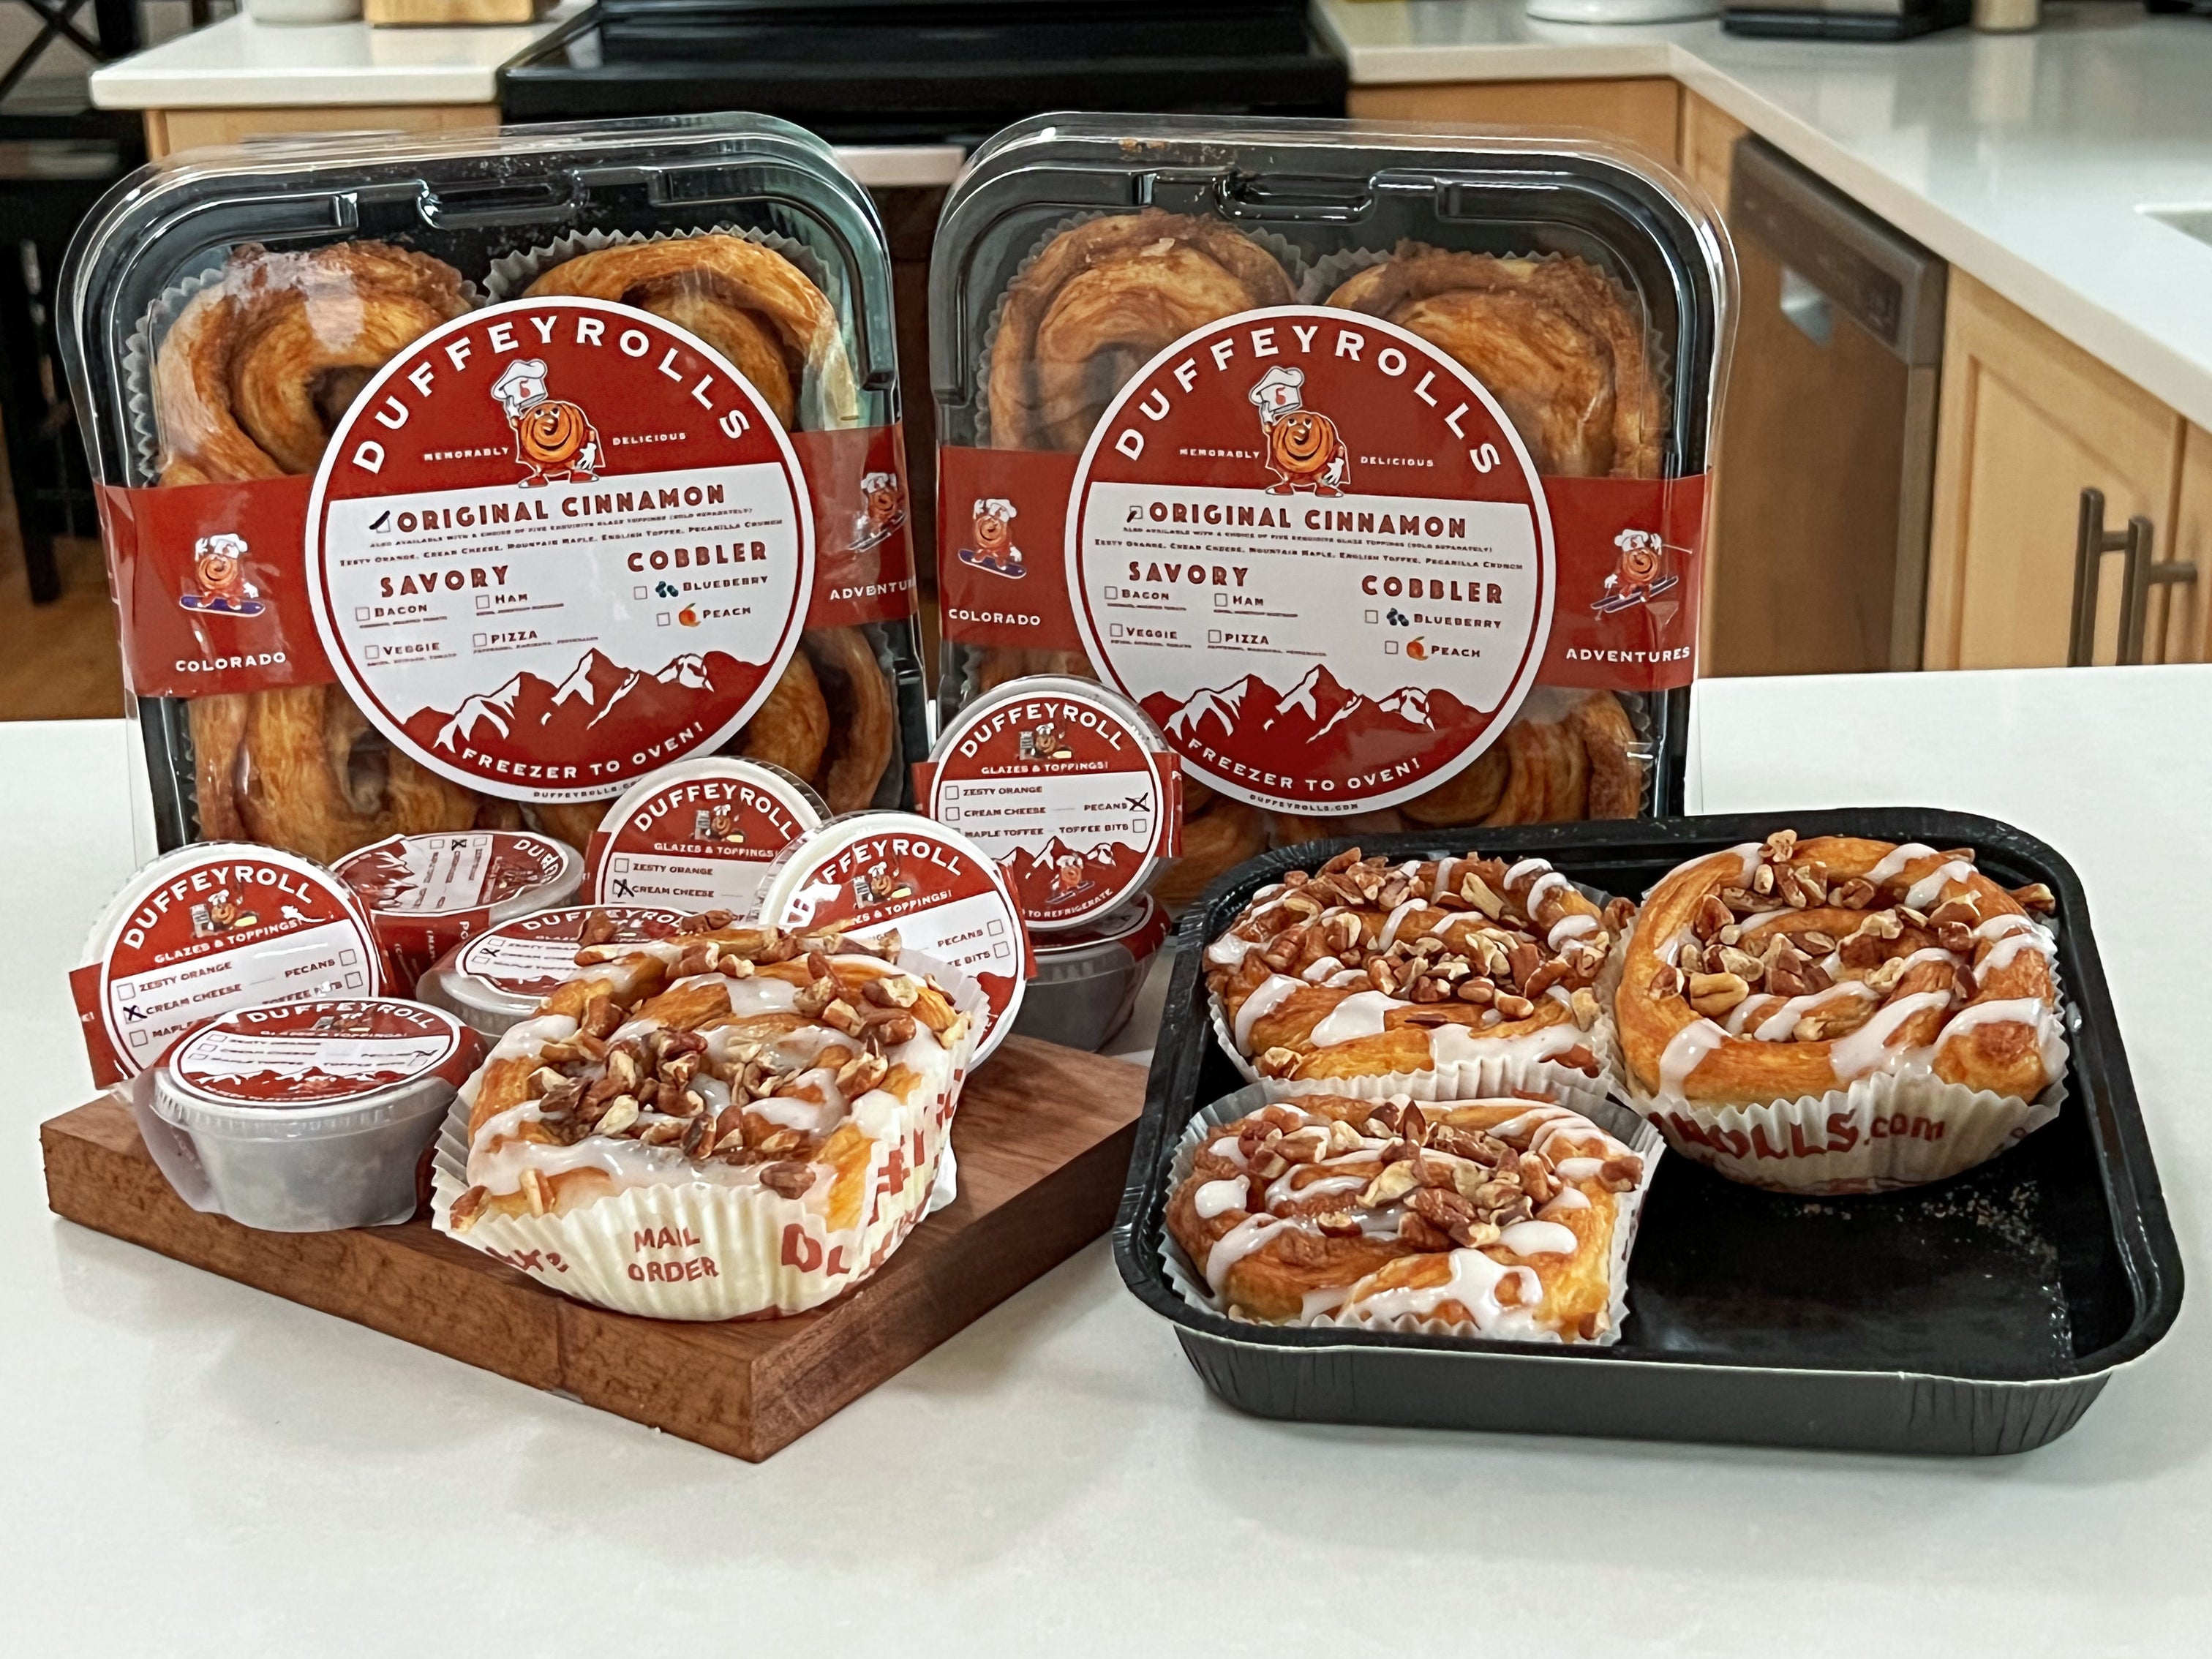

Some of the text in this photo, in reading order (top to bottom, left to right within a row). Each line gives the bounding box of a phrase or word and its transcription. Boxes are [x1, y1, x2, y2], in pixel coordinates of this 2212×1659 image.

[353, 316, 750, 473] DUFFEYROLLS
[1114, 326, 1501, 474] DUFFEYROLLS
[424, 432, 686, 461] MEMORABLY DELICIOUS
[1179, 447, 1434, 467] MEMORABLY DELICIOUS
[397, 484, 724, 533] ORIGINAL CINNAMON
[1149, 502, 1466, 538] ORIGINAL CINNAMON
[628, 541, 767, 572] COBBLER
[380, 565, 508, 598] SAVORY
[1129, 561, 1248, 587] SAVORY
[682, 576, 769, 592] BLUEBERRY
[1361, 575, 1502, 603] COBBLER
[495, 593, 528, 605] HAM
[1121, 589, 1170, 601] BACON
[1233, 595, 1264, 606] HAM
[375, 604, 428, 618] BACON
[703, 606, 751, 619] PEACH
[949, 609, 1041, 626] COLORADO
[1414, 613, 1501, 628] BLUEBERRY
[492, 631, 538, 644] PIZZA
[1126, 627, 1178, 639] VEGGIE
[1225, 633, 1270, 645] PIZZA
[383, 642, 440, 656] VEGGIE
[1432, 645, 1481, 658] PEACH
[1566, 647, 1690, 663] ADVENTURES
[176, 652, 286, 672] COLORADO
[960, 702, 1124, 759] DUFFEYROLL
[462, 721, 704, 779] FREEZER TO OVEN!
[981, 766, 1028, 775] GLAZES
[1044, 761, 1109, 772] TOPPINGS!
[1188, 738, 1421, 791] FREEZER TO OVEN!
[963, 786, 1042, 797] ZESTY ORANGE
[634, 783, 794, 840] DUFFEYROLL
[964, 807, 1046, 818] CREAM CHEESE
[1084, 802, 1127, 812] PECANS
[965, 828, 1044, 838] MAPLE TOFFEE
[1059, 824, 1129, 835] TOFFEE BITS
[654, 843, 701, 853] GLAZES
[633, 863, 713, 875] ZESTY ORANGE
[632, 885, 715, 898] CREAM CHEESE
[123, 865, 313, 950] DUFFEYROLL
[885, 889, 952, 916] TOPPINGS!
[1044, 888, 1113, 918] REFRIGERATE
[937, 929, 984, 947] PECANS
[154, 942, 210, 964] GLAZES
[965, 951, 991, 965] BITS
[139, 962, 233, 993] ZESTY ORANGE
[285, 959, 335, 978] PECANS
[146, 984, 242, 1015] CREAM CHEESE
[246, 1002, 434, 1029] DUFFEYROLL
[634, 1227, 701, 1252] MAIL
[627, 1256, 720, 1283] ORDER
